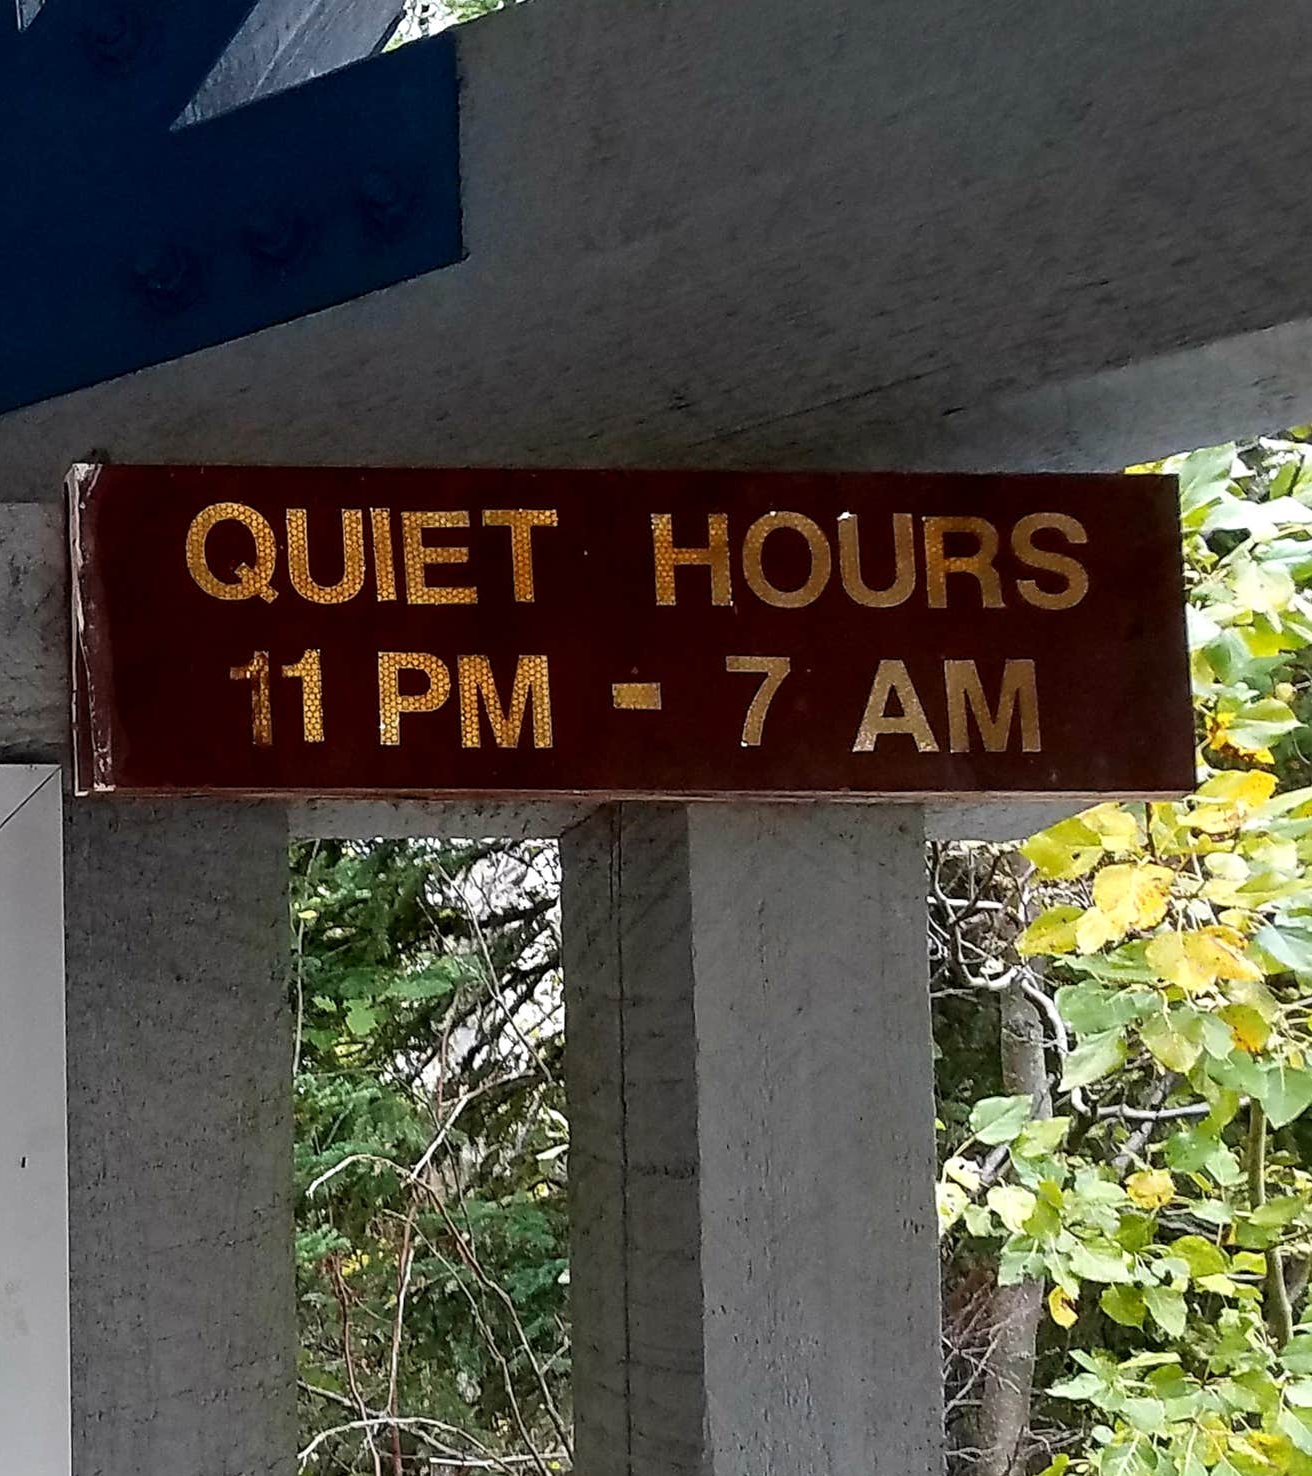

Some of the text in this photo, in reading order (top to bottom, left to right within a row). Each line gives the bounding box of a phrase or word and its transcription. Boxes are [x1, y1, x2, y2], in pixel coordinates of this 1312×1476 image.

[185, 501, 1089, 610] QUIET HOURS
[228, 648, 1042, 754] 11 PM - 7 AM
